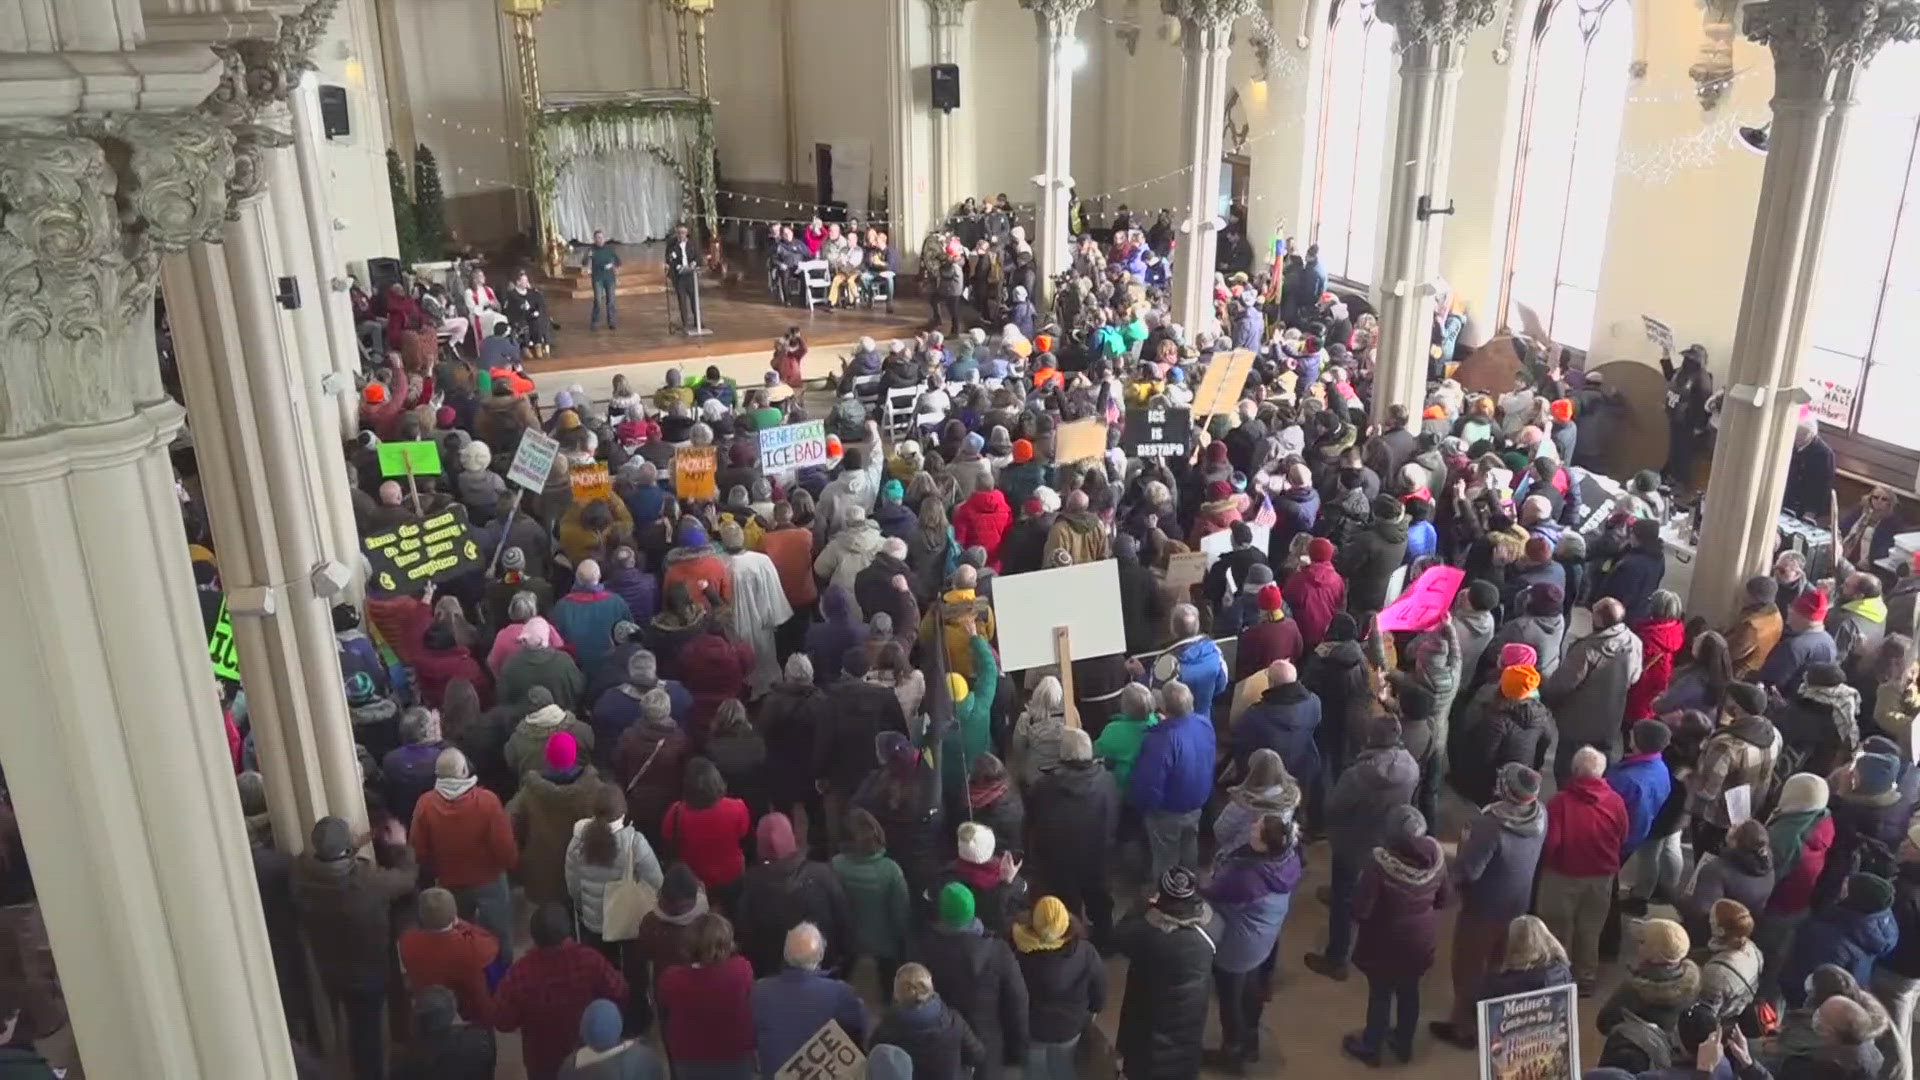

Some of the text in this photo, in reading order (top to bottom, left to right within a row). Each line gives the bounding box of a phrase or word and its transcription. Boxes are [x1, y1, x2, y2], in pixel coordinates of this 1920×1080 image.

[1148, 409, 1166, 423] ICE
[761, 427, 796, 448] RENEE
[1151, 427, 1163, 440] IS
[763, 440, 823, 467] ICE BAD
[210, 630, 240, 671] IC
[1503, 994, 1551, 1018] Maine's
[786, 1029, 841, 1080] ICE
